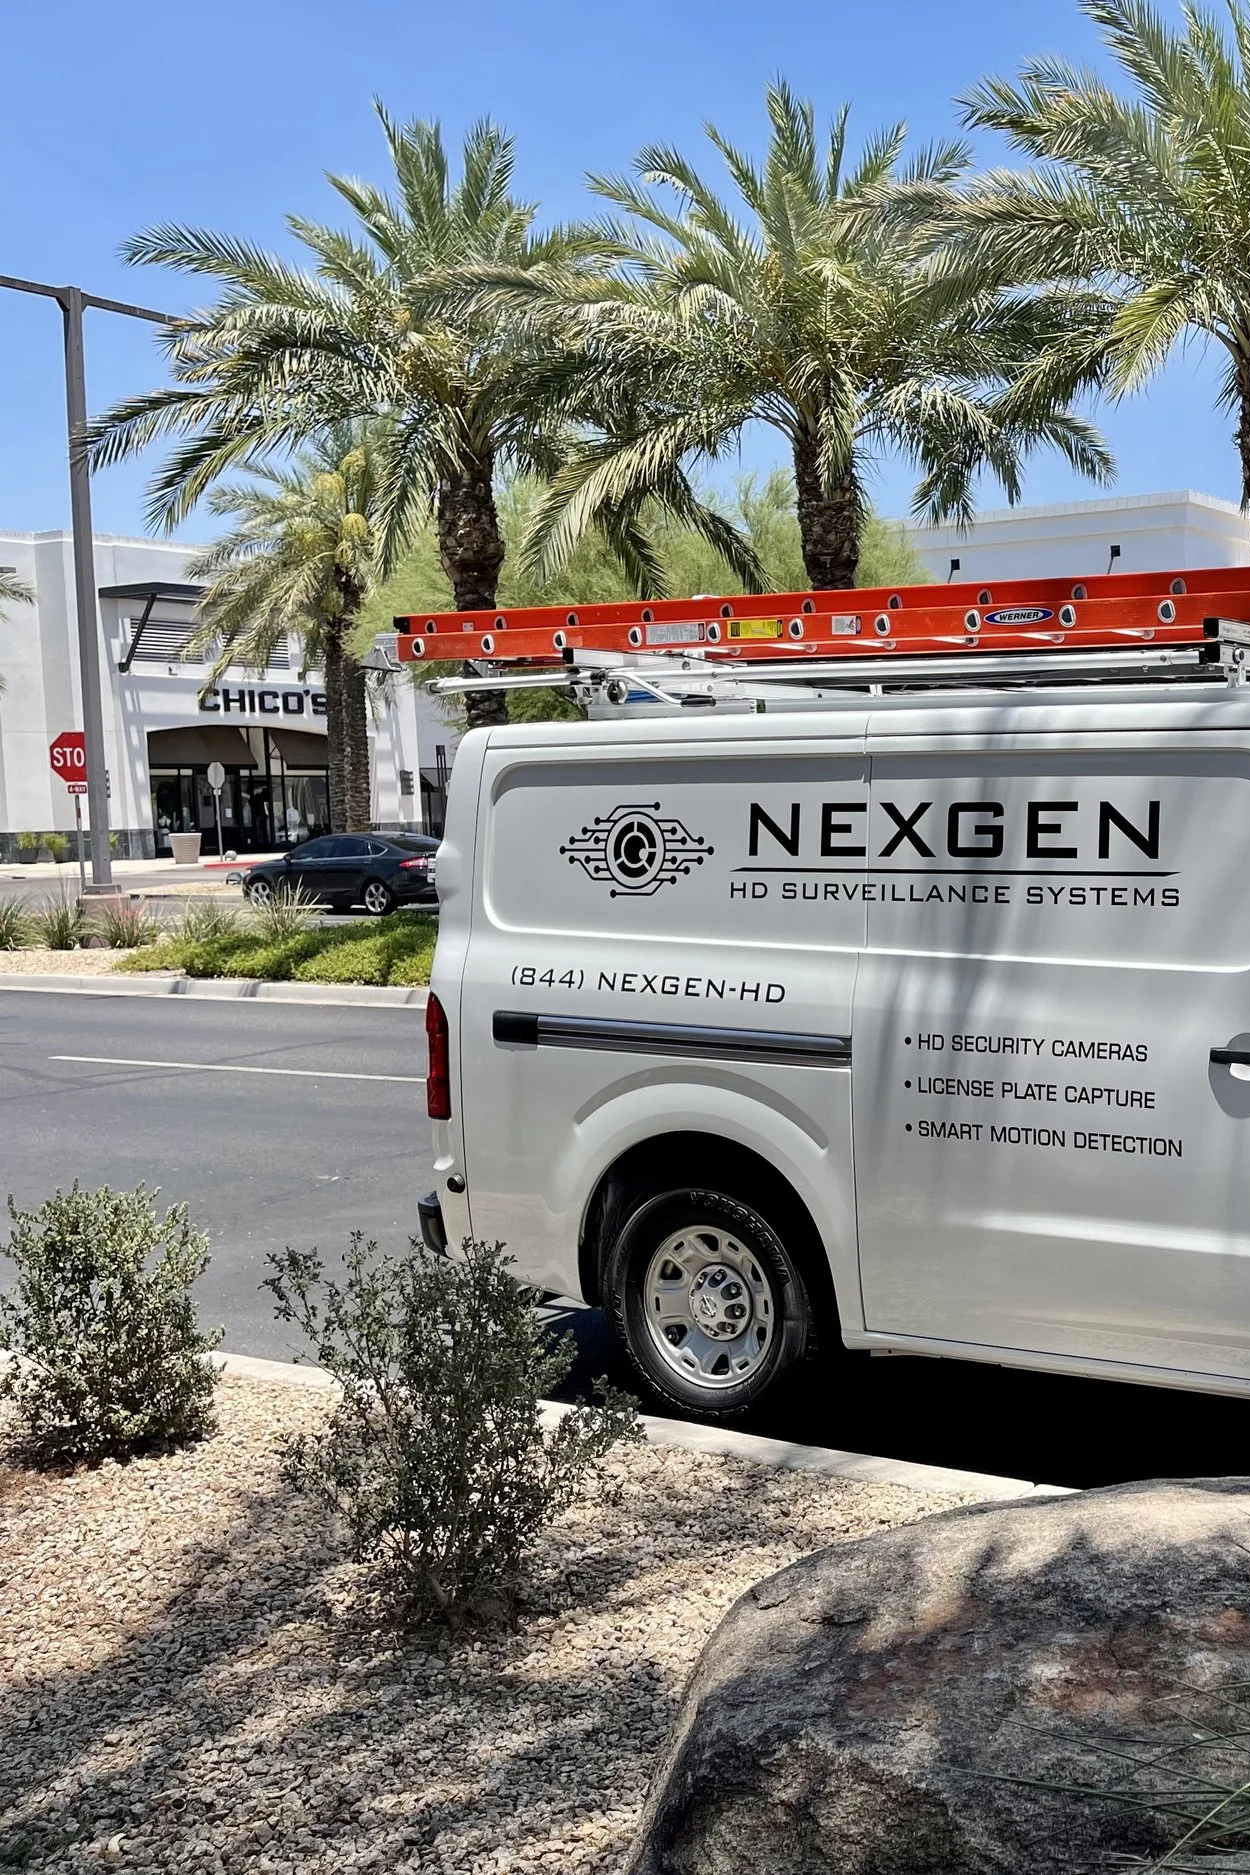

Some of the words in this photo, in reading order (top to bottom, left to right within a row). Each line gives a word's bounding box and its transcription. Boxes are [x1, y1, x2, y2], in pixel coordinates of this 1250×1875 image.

[999, 611, 1040, 621] WERNER
[197, 688, 326, 715] CHICO'S
[53, 747, 85, 767] STO
[747, 800, 1161, 860] NEXGEN
[729, 882, 769, 899] HD
[781, 883, 1010, 904] SURVEILLANCE
[1026, 887, 1180, 907] SYSTEMS
[511, 965, 585, 990] (844)
[597, 971, 786, 1004] NEXGEN-HD
[917, 1033, 945, 1051] HD
[951, 1035, 1045, 1056] SECURITY
[1051, 1039, 1148, 1062] CAMERAS
[917, 1076, 994, 1098] LICENSE
[1001, 1081, 1057, 1102] PLATE
[1064, 1085, 1156, 1110] CAPTURE
[918, 1120, 983, 1141] SMART
[990, 1125, 1066, 1147] MOTION
[1073, 1131, 1183, 1158] DETECTION
[689, 1190, 791, 1286] YOKOHAMA
